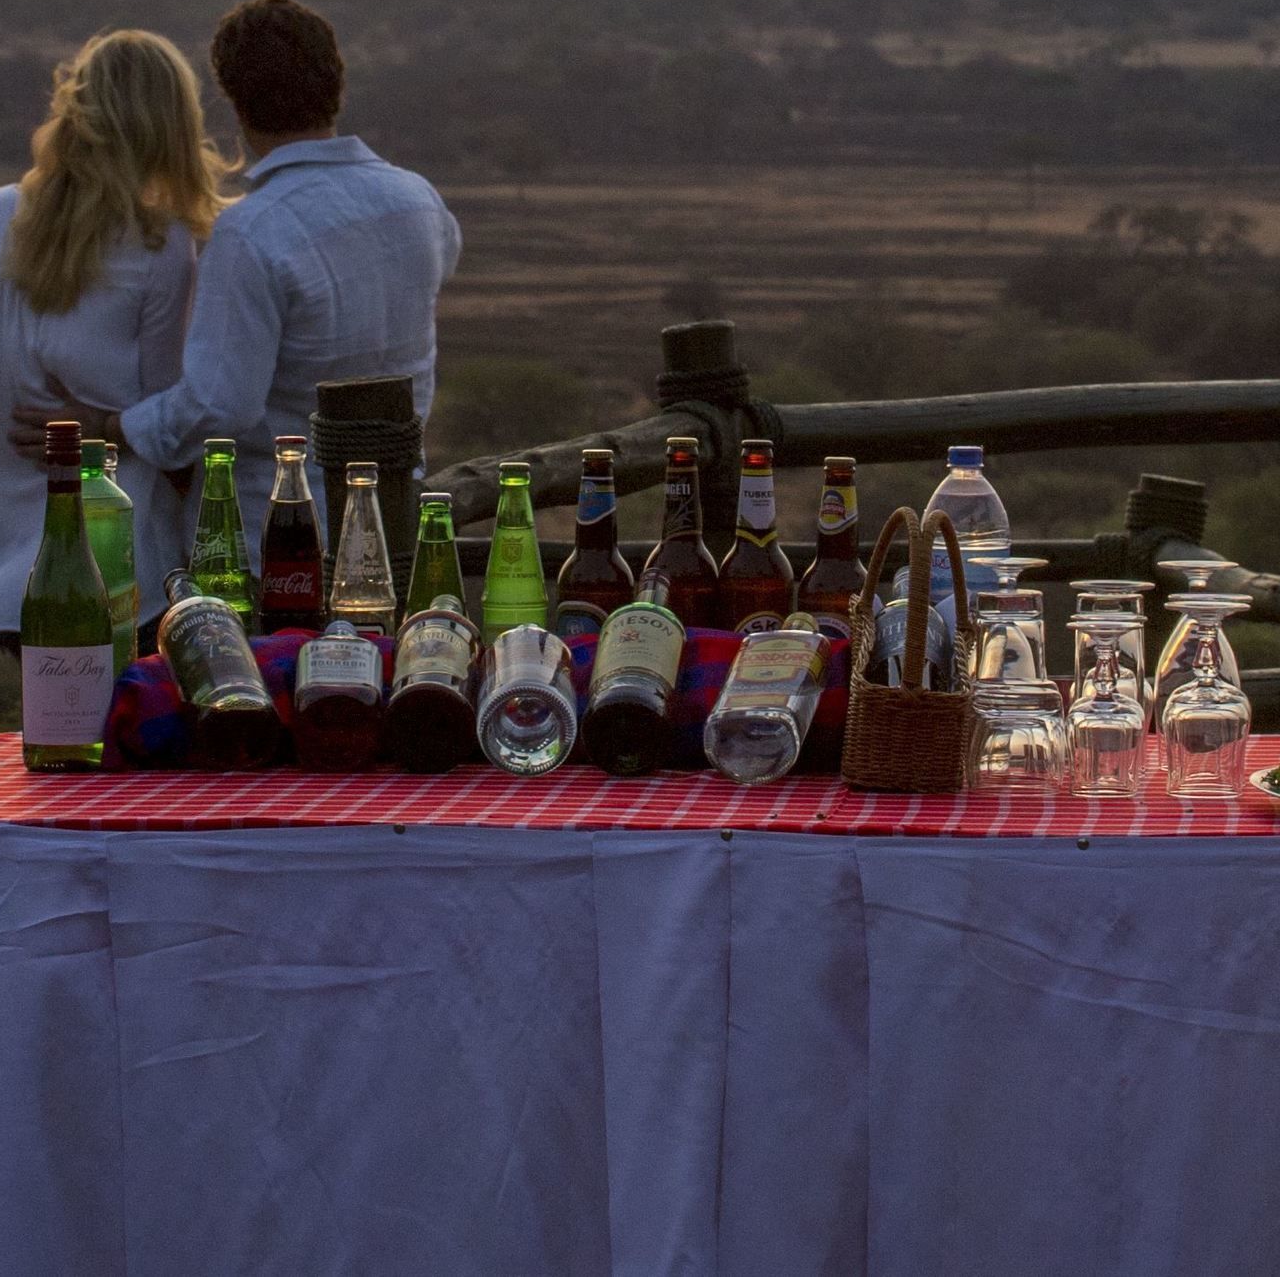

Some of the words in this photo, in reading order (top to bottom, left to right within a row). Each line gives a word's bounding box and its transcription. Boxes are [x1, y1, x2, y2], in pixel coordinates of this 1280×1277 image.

[744, 490, 775, 498] TUSKE
[263, 571, 314, 595] Coca-Cola
[613, 615, 674, 638] MESON
[34, 655, 72, 676] False
[73, 655, 106, 683] Bay
